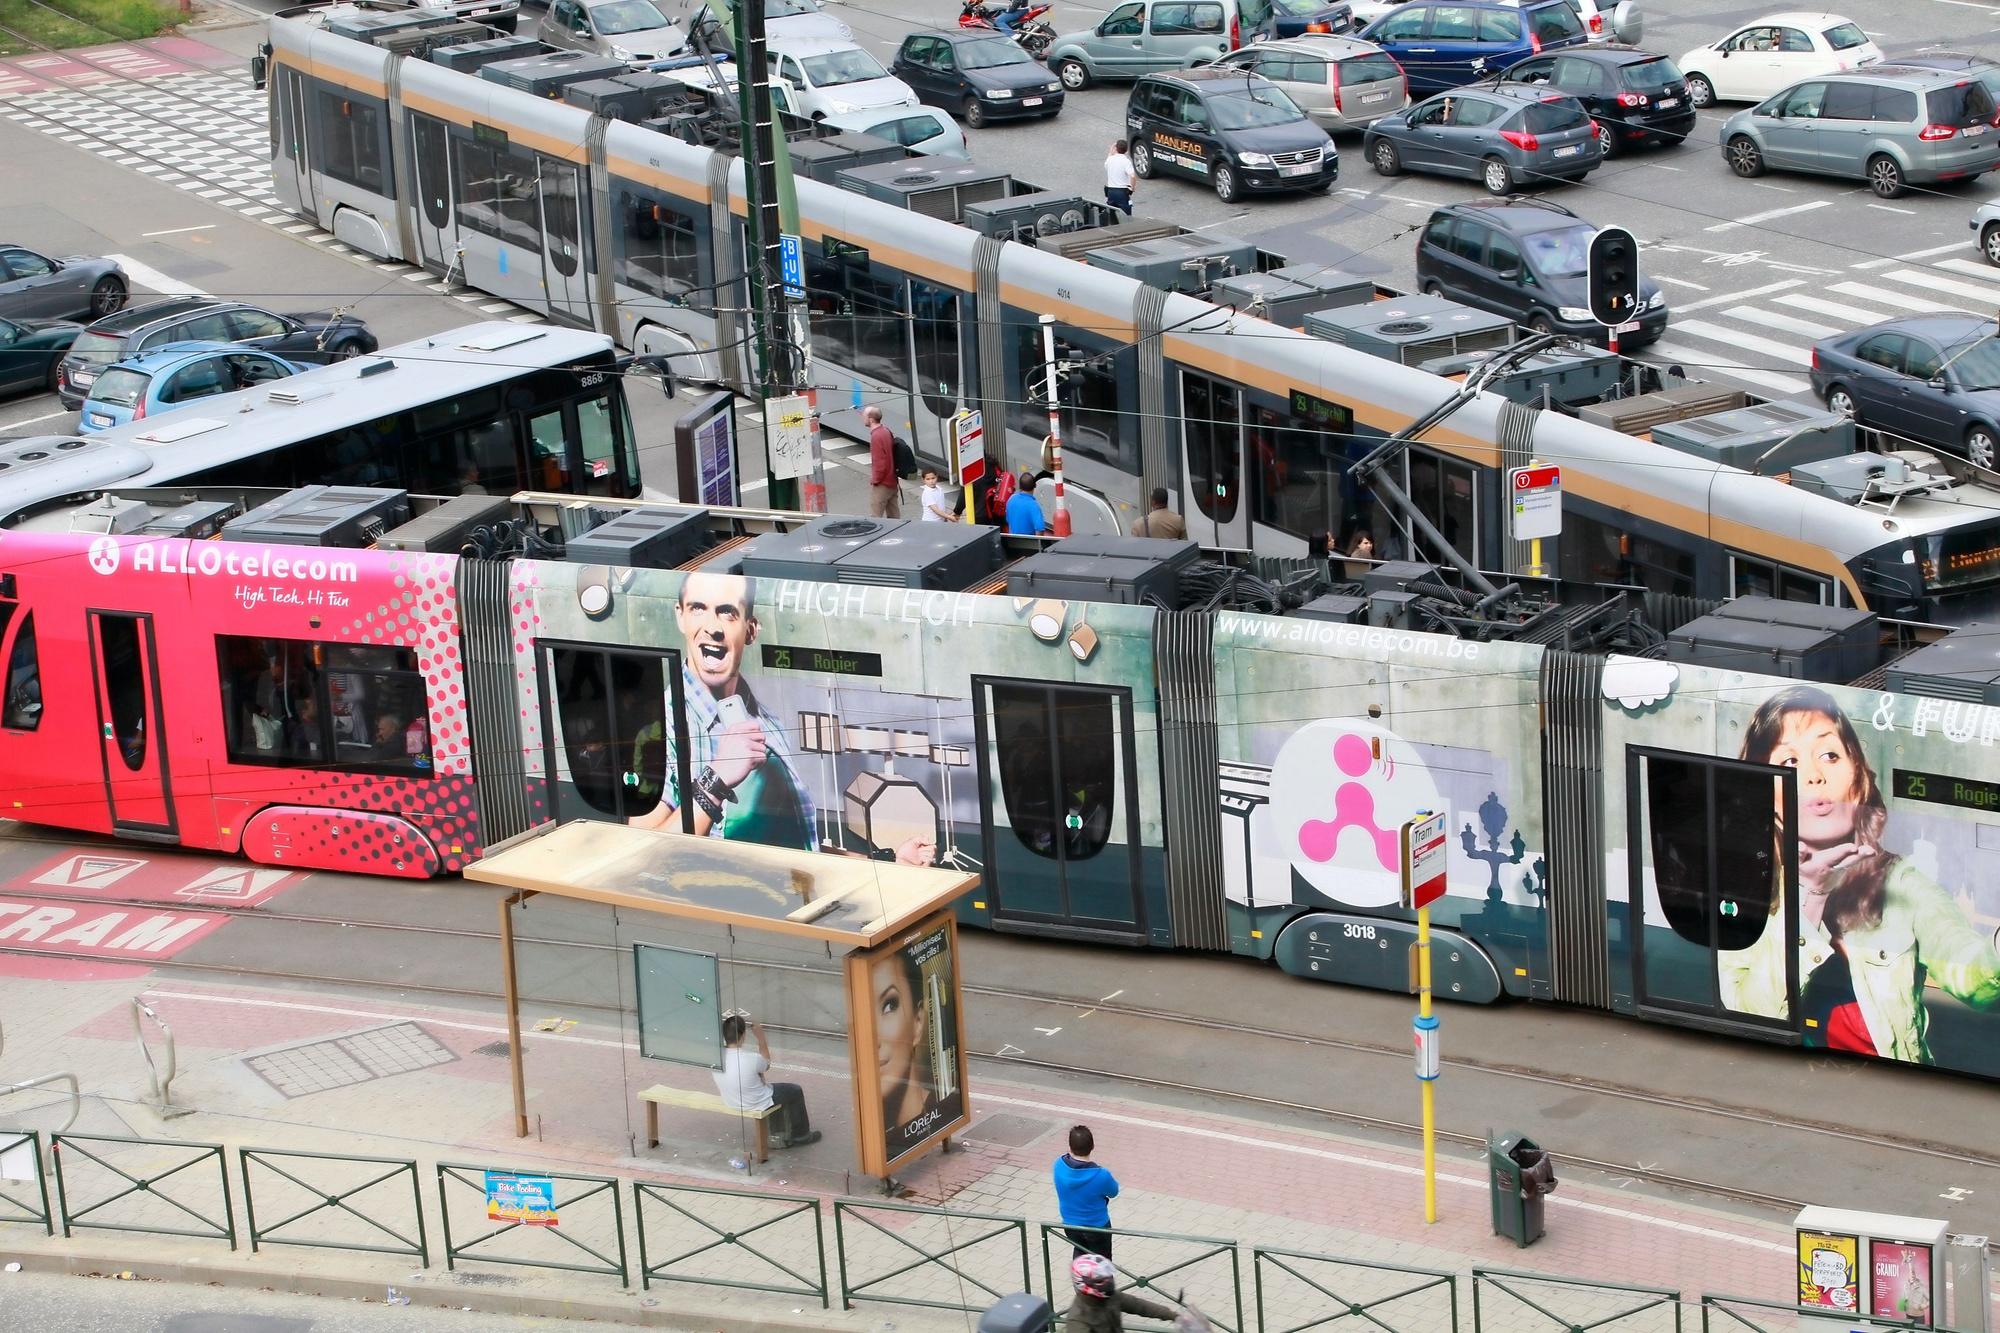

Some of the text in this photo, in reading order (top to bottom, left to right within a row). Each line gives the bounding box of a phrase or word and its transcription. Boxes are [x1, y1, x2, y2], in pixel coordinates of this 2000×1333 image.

[1154, 132, 1202, 155] MANUFAR
[787, 240, 799, 293] BUS
[1056, 287, 1071, 300] 4014
[581, 372, 603, 387] 8868
[960, 421, 973, 433] Tram
[133, 542, 358, 582] ALLOtelecom
[234, 585, 350, 609] High Tech, Hi Fun
[778, 578, 978, 628] HIGH TECH
[1218, 615, 1480, 661] www.allotelecom.be
[774, 650, 859, 673] 25 Rogier
[1907, 776, 1927, 797] 25
[1414, 826, 1432, 843] Tram
[0, 902, 210, 952] TRAM
[1343, 923, 1376, 939] 3018
[915, 954, 927, 966] vos
[498, 1182, 542, 1195] Bike Pooling
